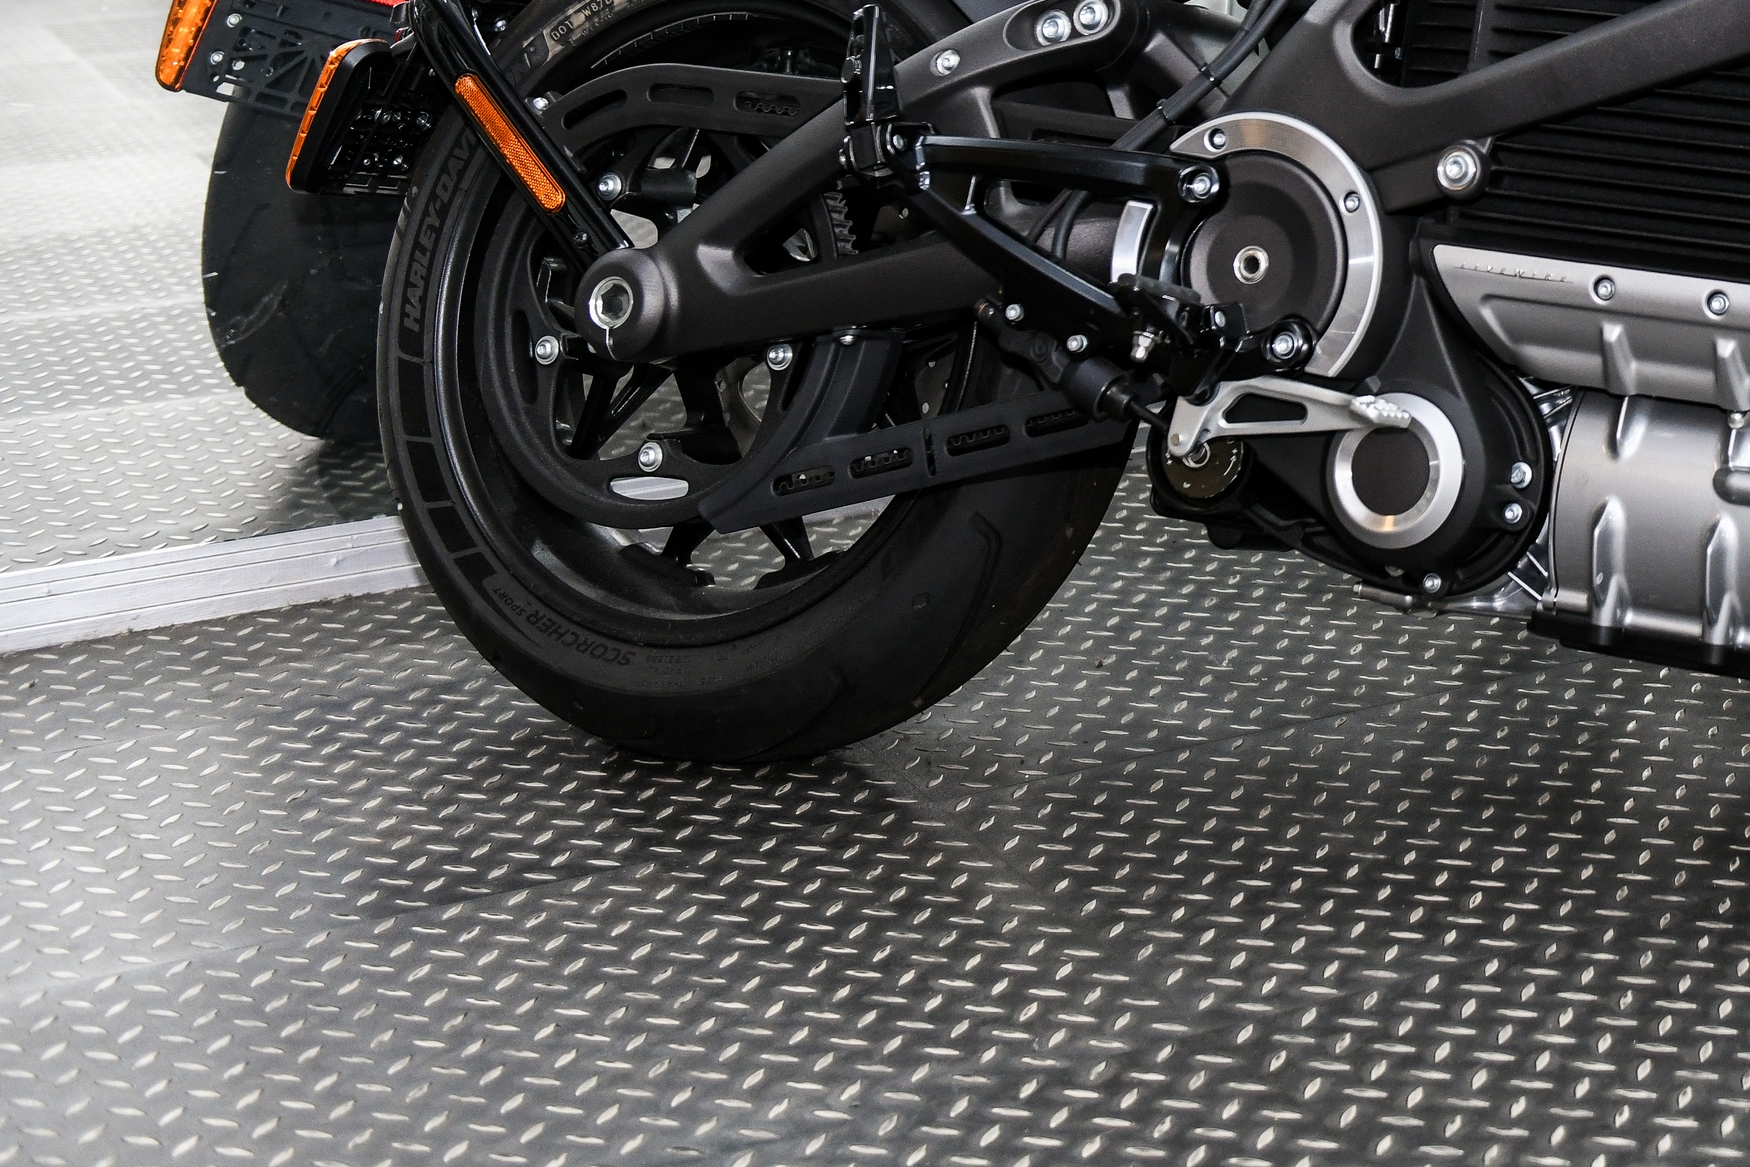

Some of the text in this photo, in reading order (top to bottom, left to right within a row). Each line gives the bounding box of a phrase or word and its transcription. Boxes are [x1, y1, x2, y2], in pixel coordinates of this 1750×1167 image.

[550, 17, 575, 41] DOT
[490, 586, 528, 619] SPORT
[525, 607, 637, 667] SCORCHER
